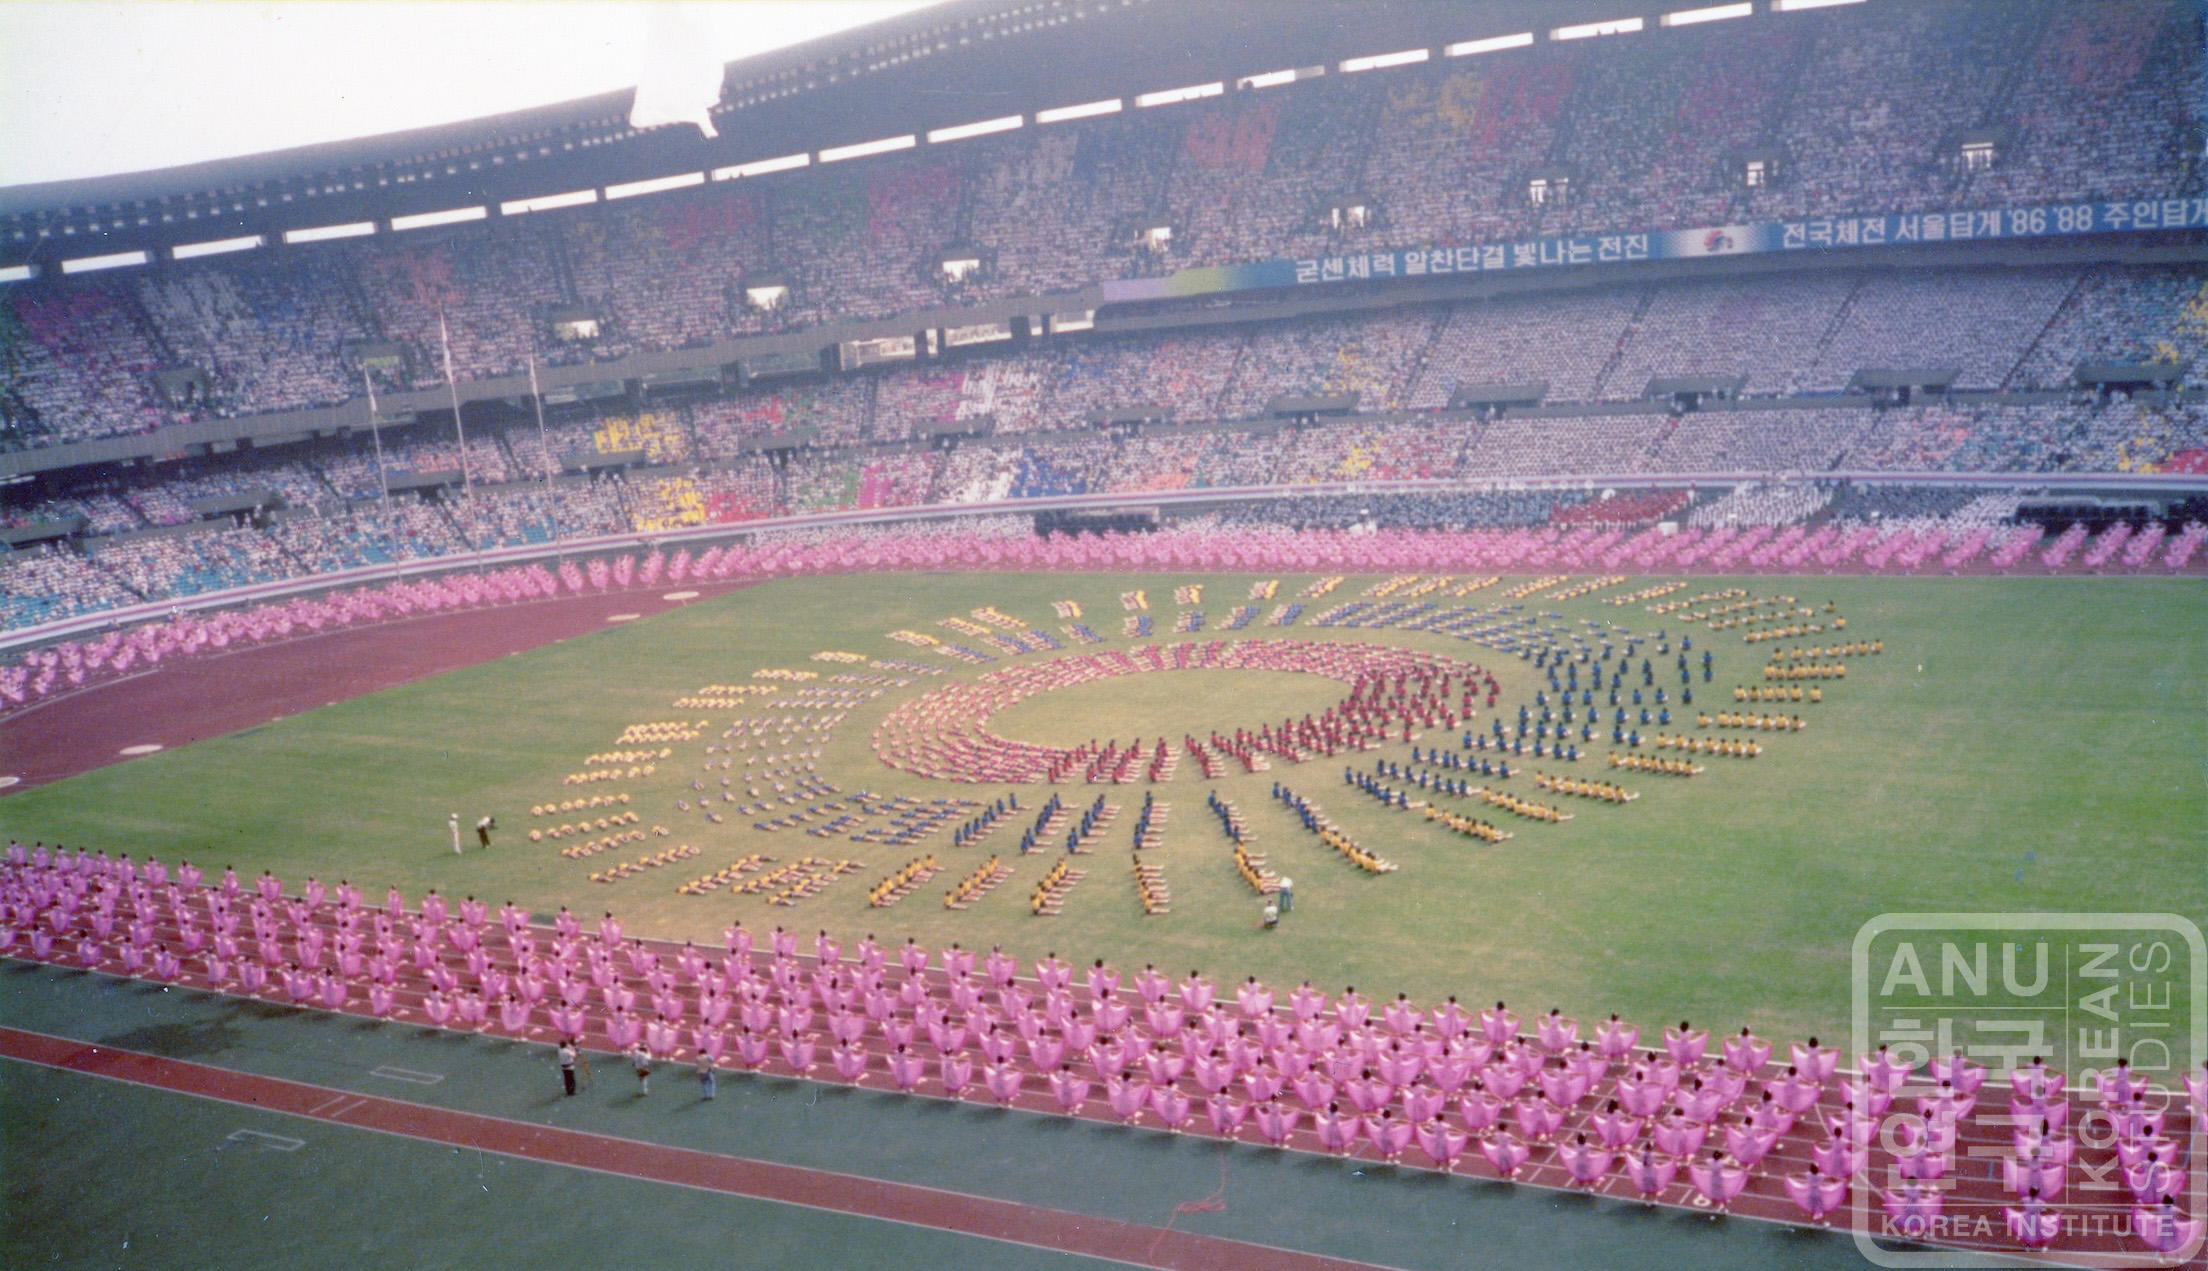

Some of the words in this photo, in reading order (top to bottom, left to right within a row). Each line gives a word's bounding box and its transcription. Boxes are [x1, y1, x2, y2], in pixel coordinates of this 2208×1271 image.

[1783, 217, 1886, 249] 전국체전
[1895, 210, 2001, 241] 서울답게
[2006, 207, 2046, 236] '86
[2052, 204, 2093, 233] '88
[1296, 253, 1396, 284] 굳센체력
[1404, 244, 1505, 275] 알찬단결
[1513, 239, 1593, 268] 빛나는
[1598, 233, 1648, 261] 전진
